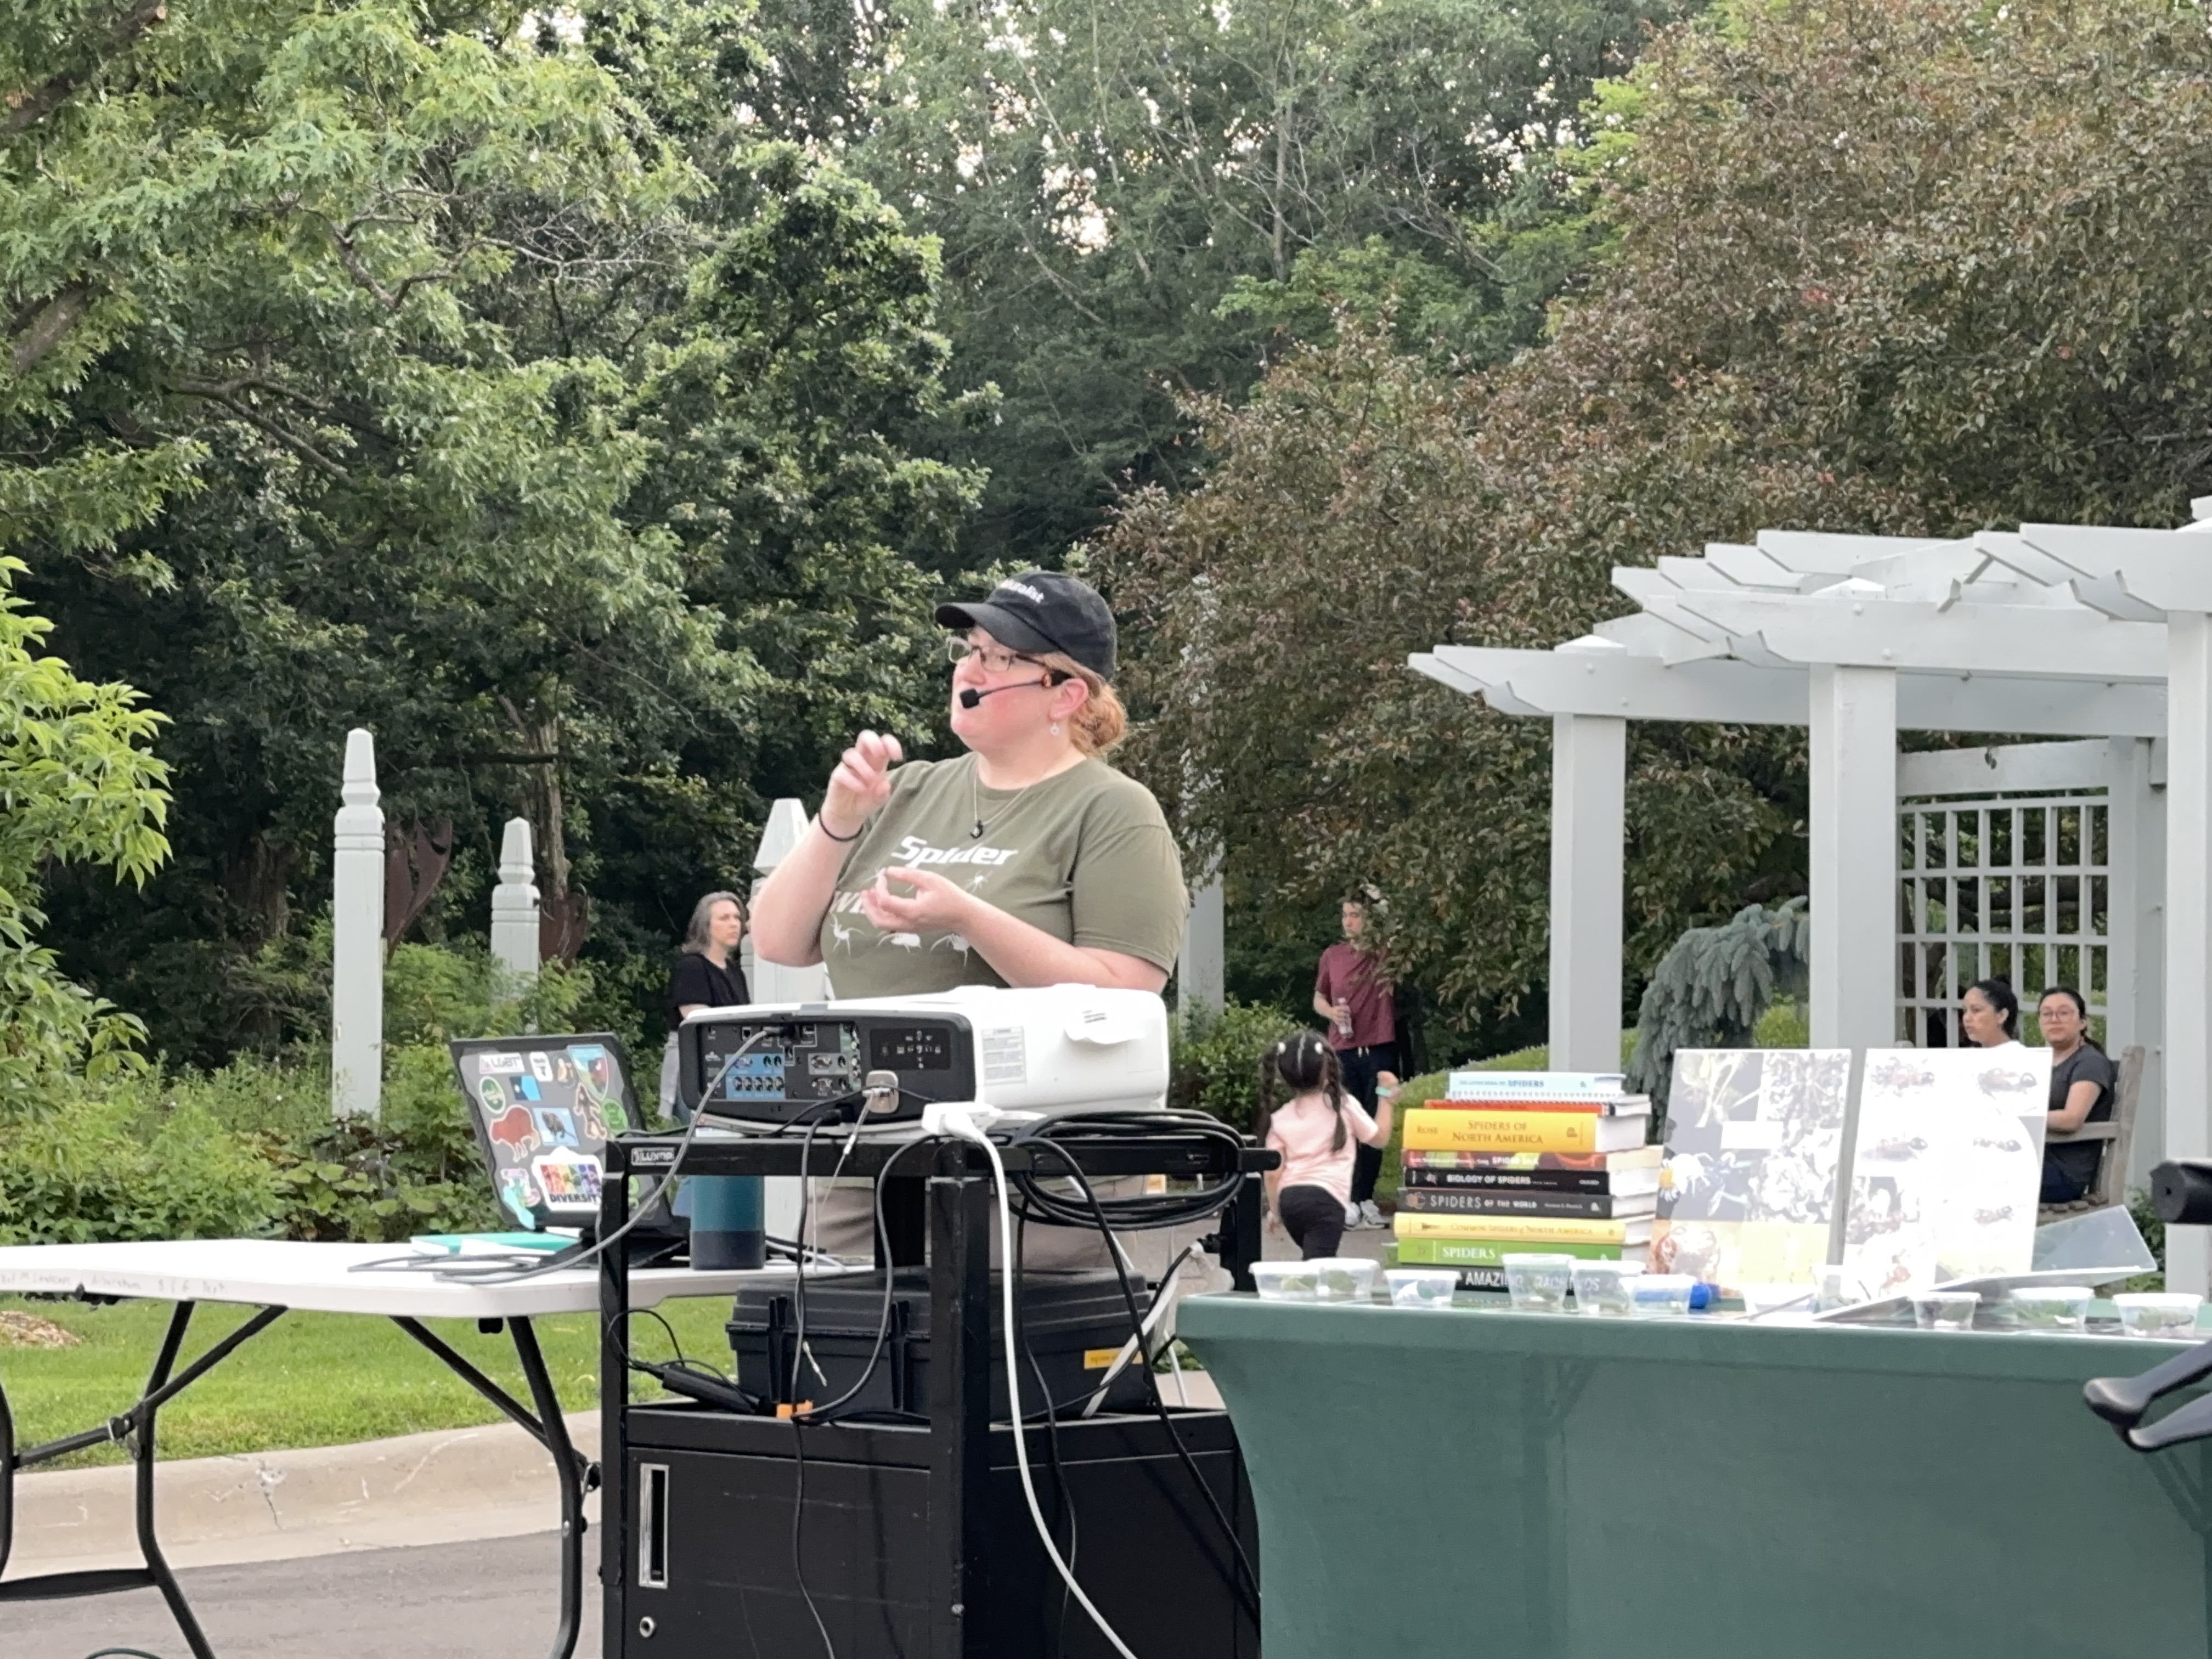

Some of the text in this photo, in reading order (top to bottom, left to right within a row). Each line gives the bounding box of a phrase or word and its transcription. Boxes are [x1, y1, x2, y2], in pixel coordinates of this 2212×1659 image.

[891, 836, 1019, 870] Spider
[1508, 1079, 1544, 1088] SPIDERS
[1417, 1126, 1438, 1135] ROSE
[1468, 1120, 1510, 1131] SPIDERS
[1452, 1131, 1543, 1144] NORTH AMERICA
[1446, 1174, 1483, 1183] BIOLOGY
[1484, 1175, 1496, 1184] OF
[1497, 1176, 1532, 1185] SPIDERS
[1430, 1195, 1482, 1209] SPIDERS
[1513, 1200, 1538, 1209] WORLD
[1442, 1246, 1496, 1260] SPIDERS
